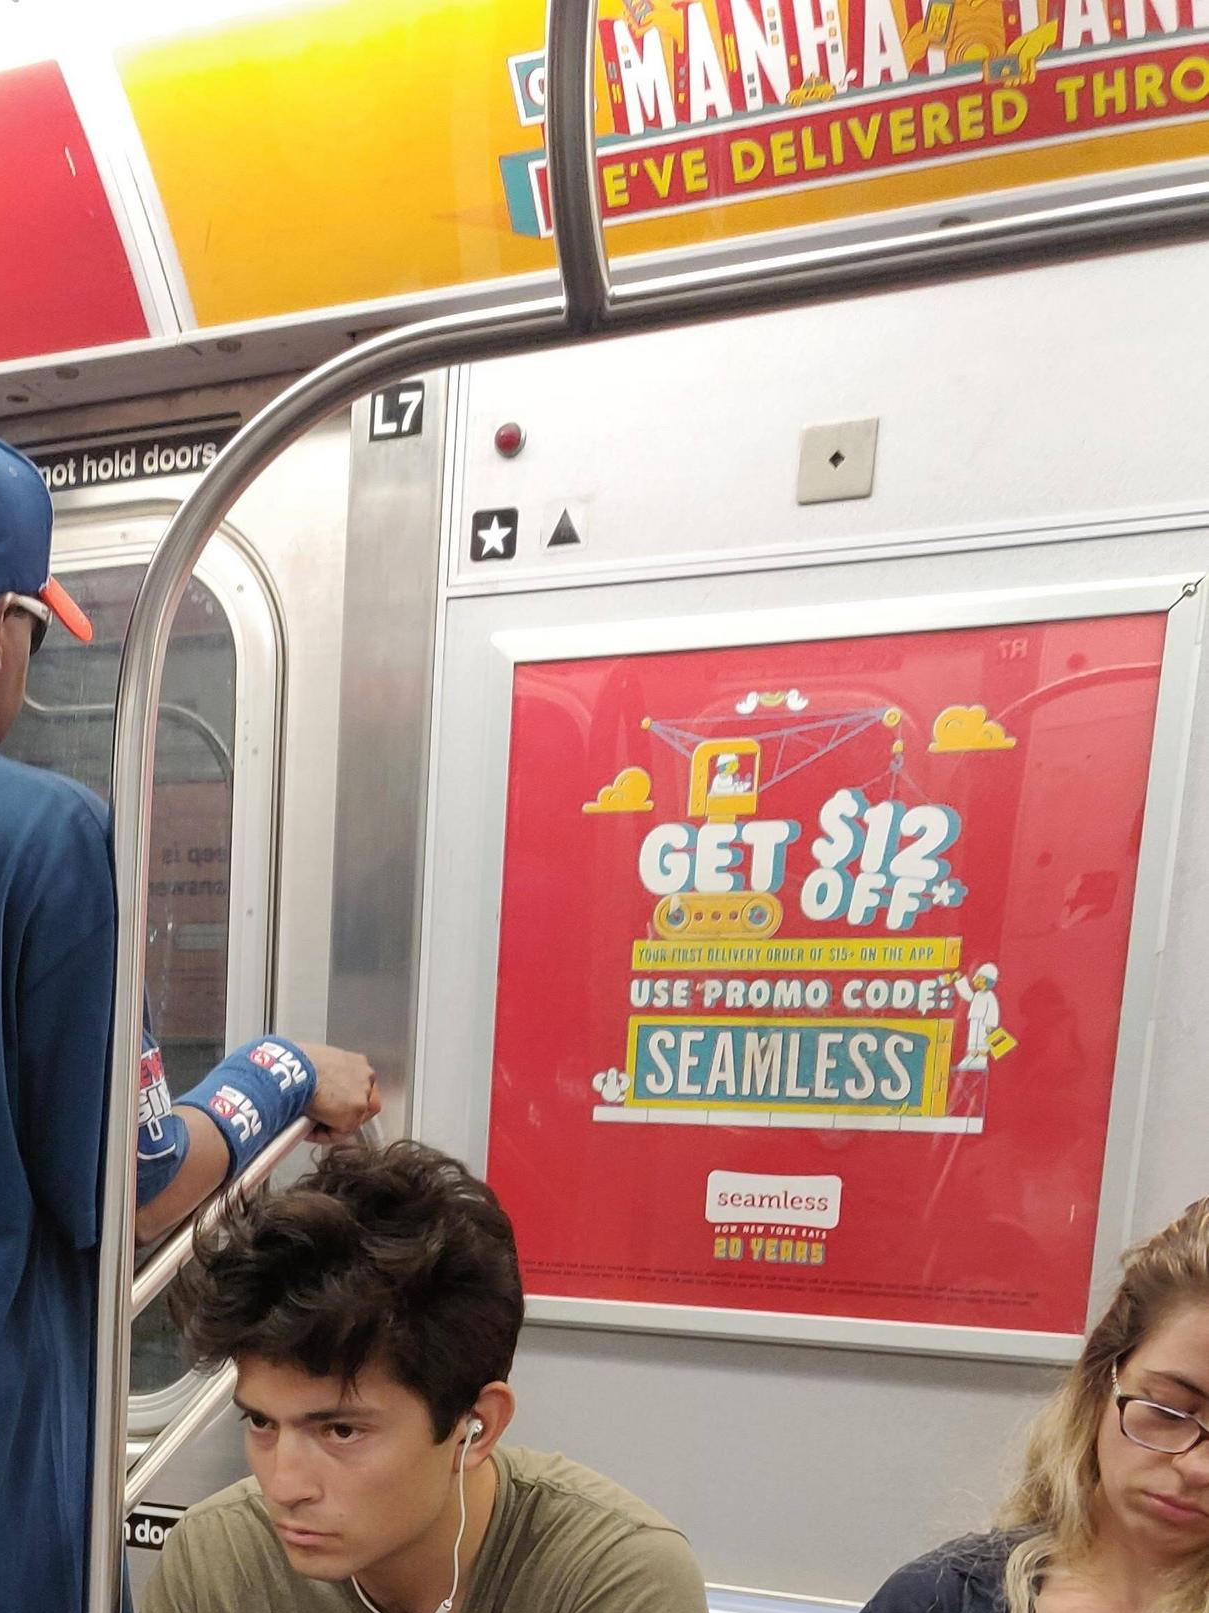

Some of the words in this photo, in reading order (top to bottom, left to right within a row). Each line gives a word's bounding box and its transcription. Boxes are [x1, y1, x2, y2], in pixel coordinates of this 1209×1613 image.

[603, 148, 708, 209] E'VE
[731, 89, 1029, 185] DELIVERED
[373, 390, 423, 436] L7
[82, 448, 136, 484] hold
[142, 442, 217, 475] doors
[811, 788, 955, 881] $12
[639, 820, 793, 895] GET
[638, 948, 666, 962] YOUR
[671, 947, 702, 962] FIRST
[707, 947, 761, 962] DELIVERY
[766, 947, 804, 962] ORDER
[809, 947, 823, 961] OF
[860, 947, 877, 961] ON
[882, 947, 903, 961] THE
[909, 947, 934, 961] APP
[630, 978, 690, 1008] USE
[703, 978, 833, 1010] PROMO
[842, 978, 954, 1015] CODE:
[644, 1029, 915, 1102] SEAMLESS
[717, 1190, 829, 1212] seamless
[713, 1237, 743, 1260] 20
[750, 1237, 825, 1265] YEARS
[714, 1225, 738, 1234] HOW
[742, 1225, 765, 1235] NEW
[770, 1227, 797, 1236] YORK
[801, 1229, 828, 1239] EATS
